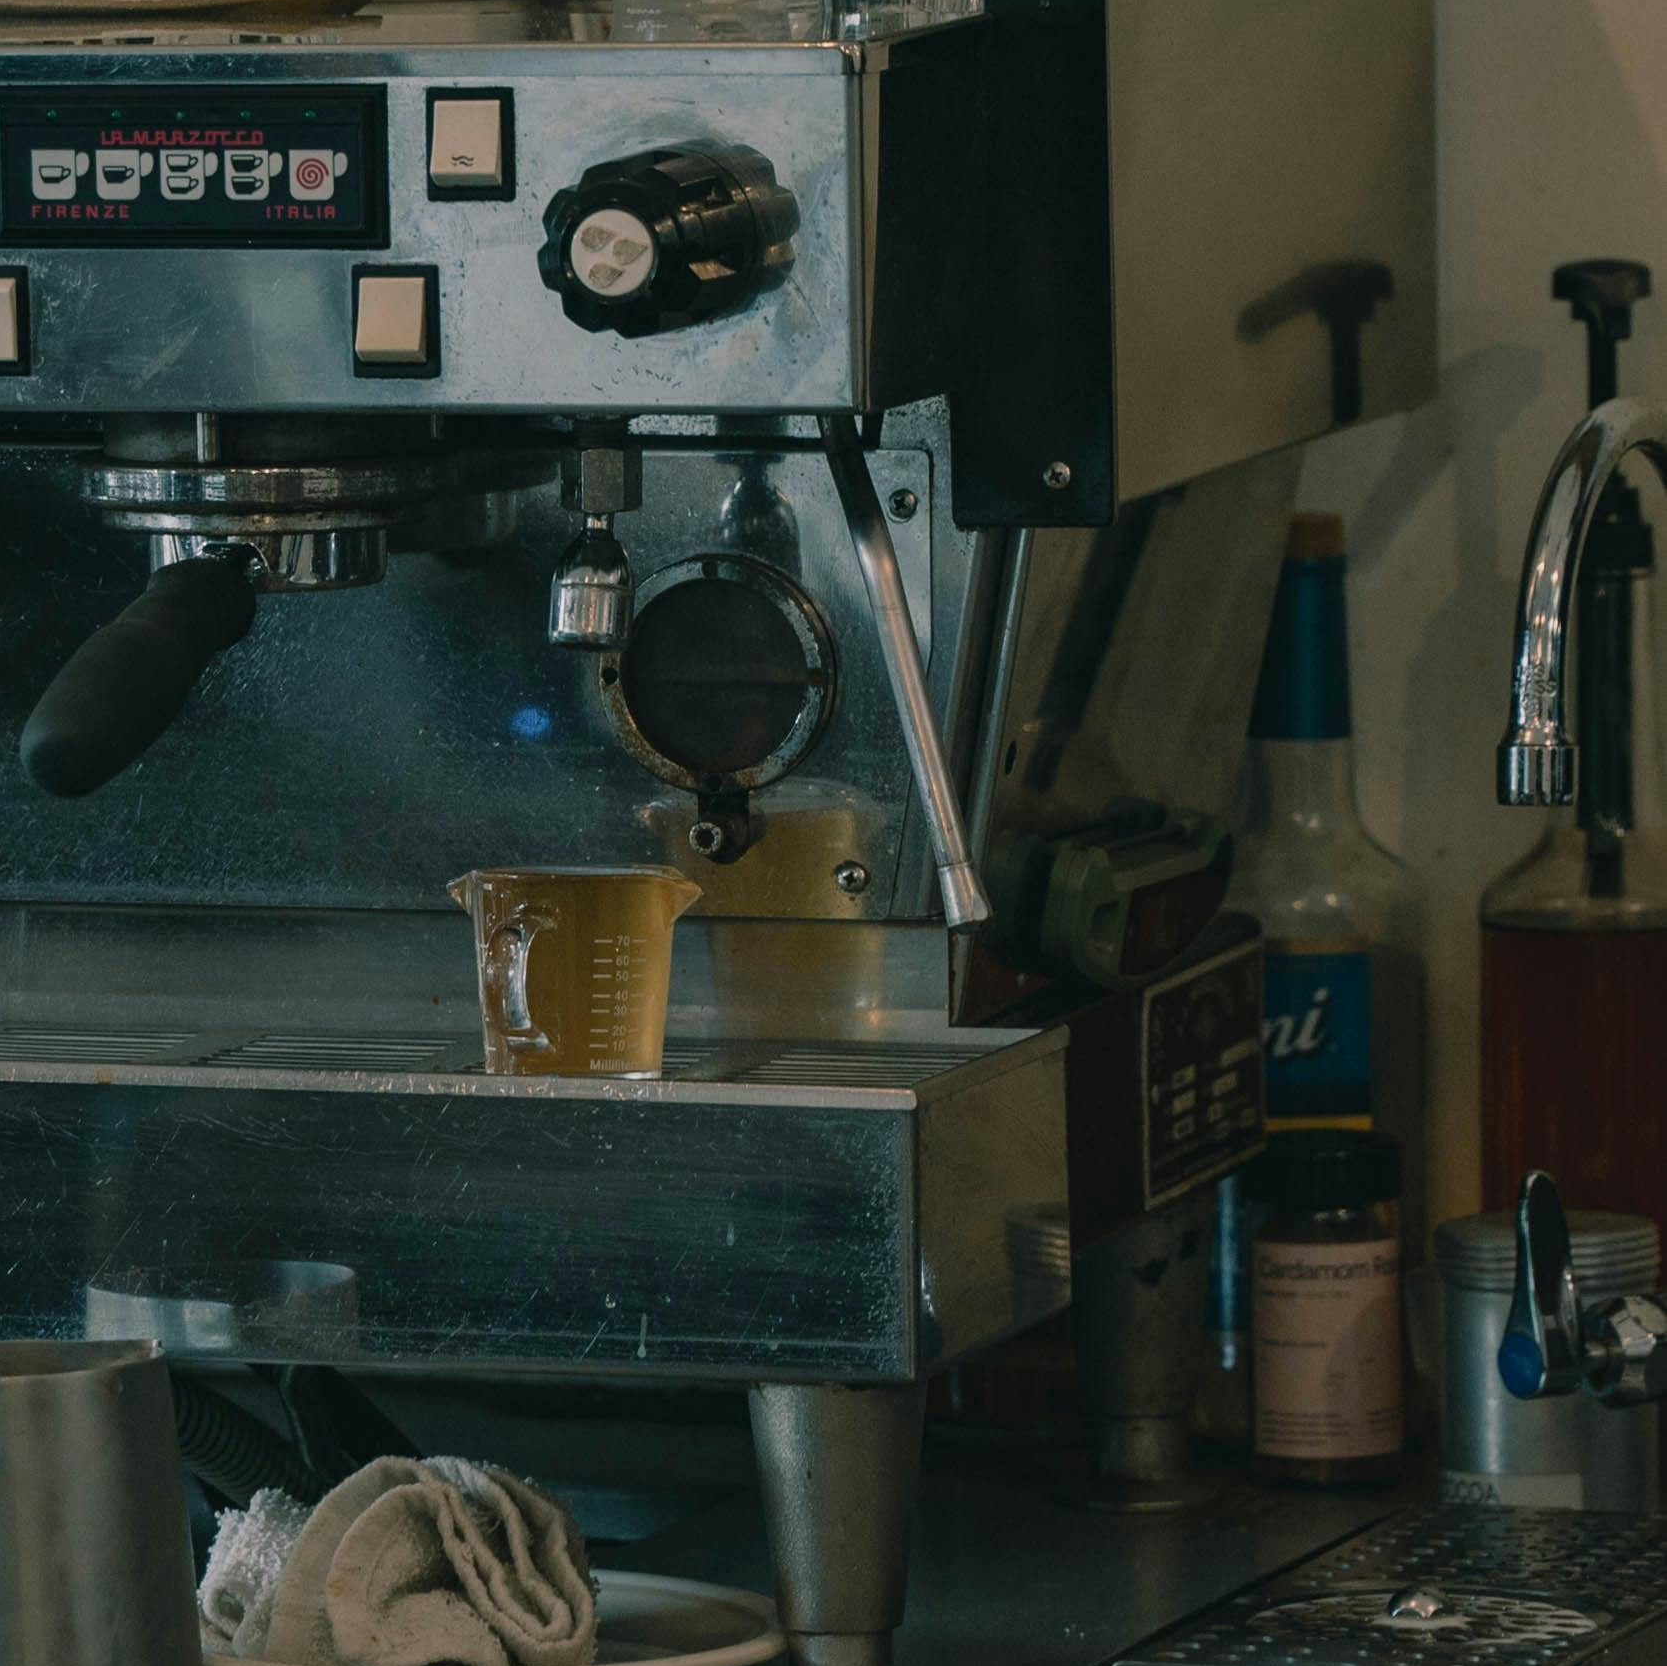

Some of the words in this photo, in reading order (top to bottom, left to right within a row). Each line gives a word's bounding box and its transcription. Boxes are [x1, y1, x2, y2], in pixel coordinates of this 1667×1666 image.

[100, 130, 123, 146] LA
[133, 130, 265, 146] MARZOCCO
[30, 204, 130, 219] FIRENZE
[265, 204, 335, 219] ITALIA
[616, 935, 631, 947] 70
[615, 955, 630, 966] 60
[615, 970, 629, 982] 50
[614, 990, 629, 1001] 40
[613, 1004, 628, 1016] 30
[612, 1025, 626, 1036] 20
[613, 1040, 626, 1052] 10
